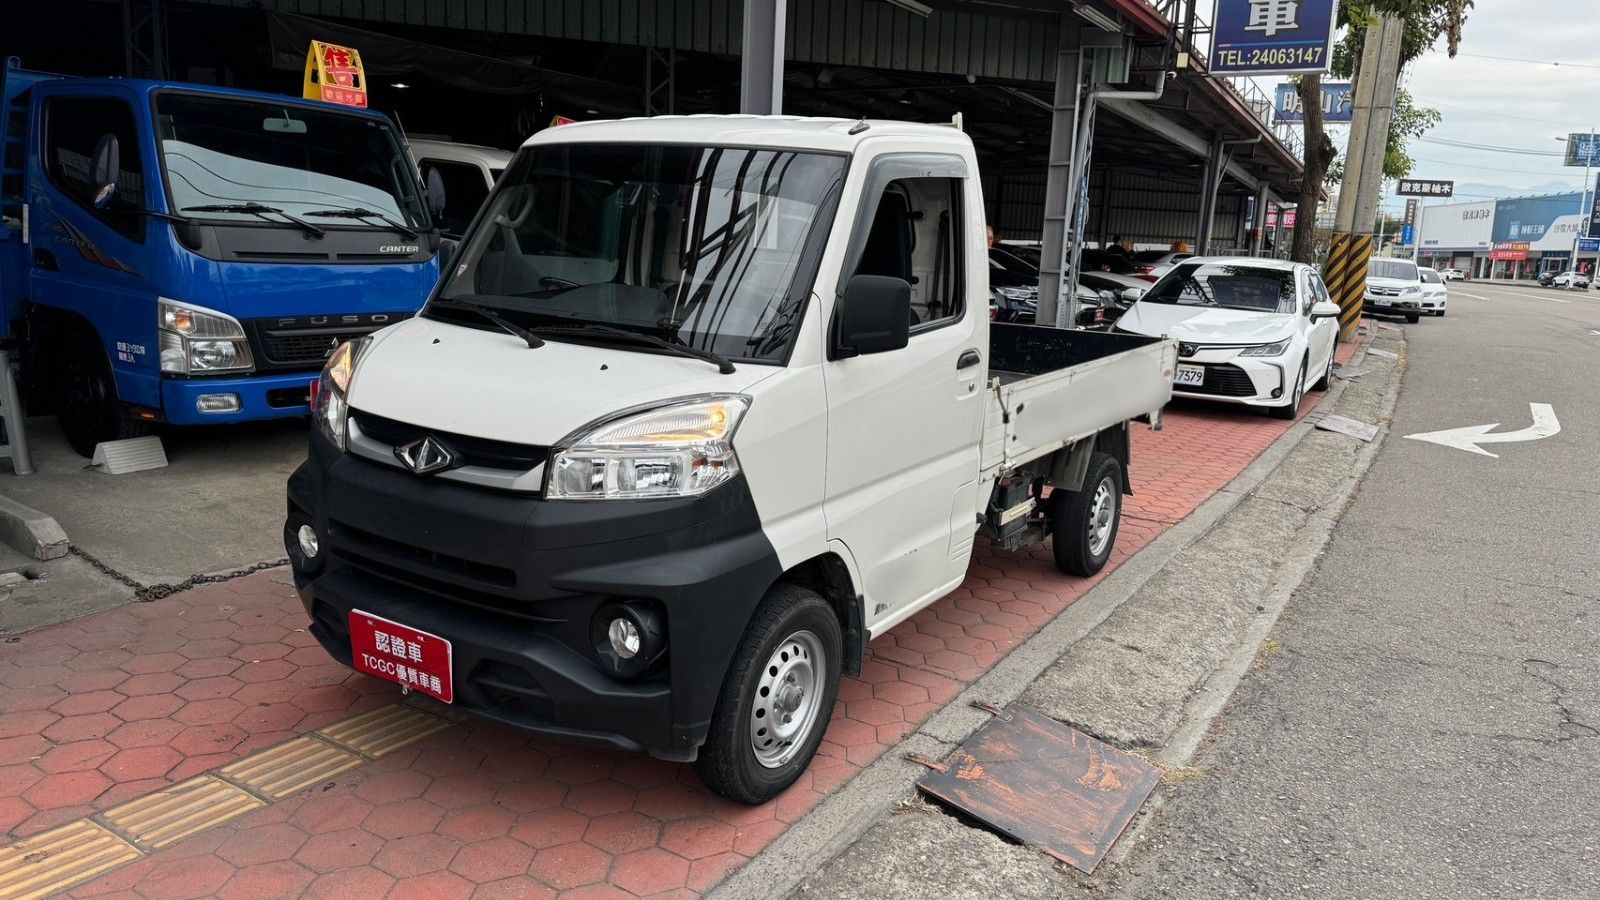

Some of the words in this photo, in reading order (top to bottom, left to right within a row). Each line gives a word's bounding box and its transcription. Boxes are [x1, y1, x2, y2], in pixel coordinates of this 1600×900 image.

[1244, 0, 1299, 36] 車
[323, 46, 359, 87] 售
[1218, 47, 1323, 66] TEL:24063147
[379, 245, 419, 253] CANTER
[278, 314, 389, 327] FUSO
[374, 630, 423, 663] 認證車
